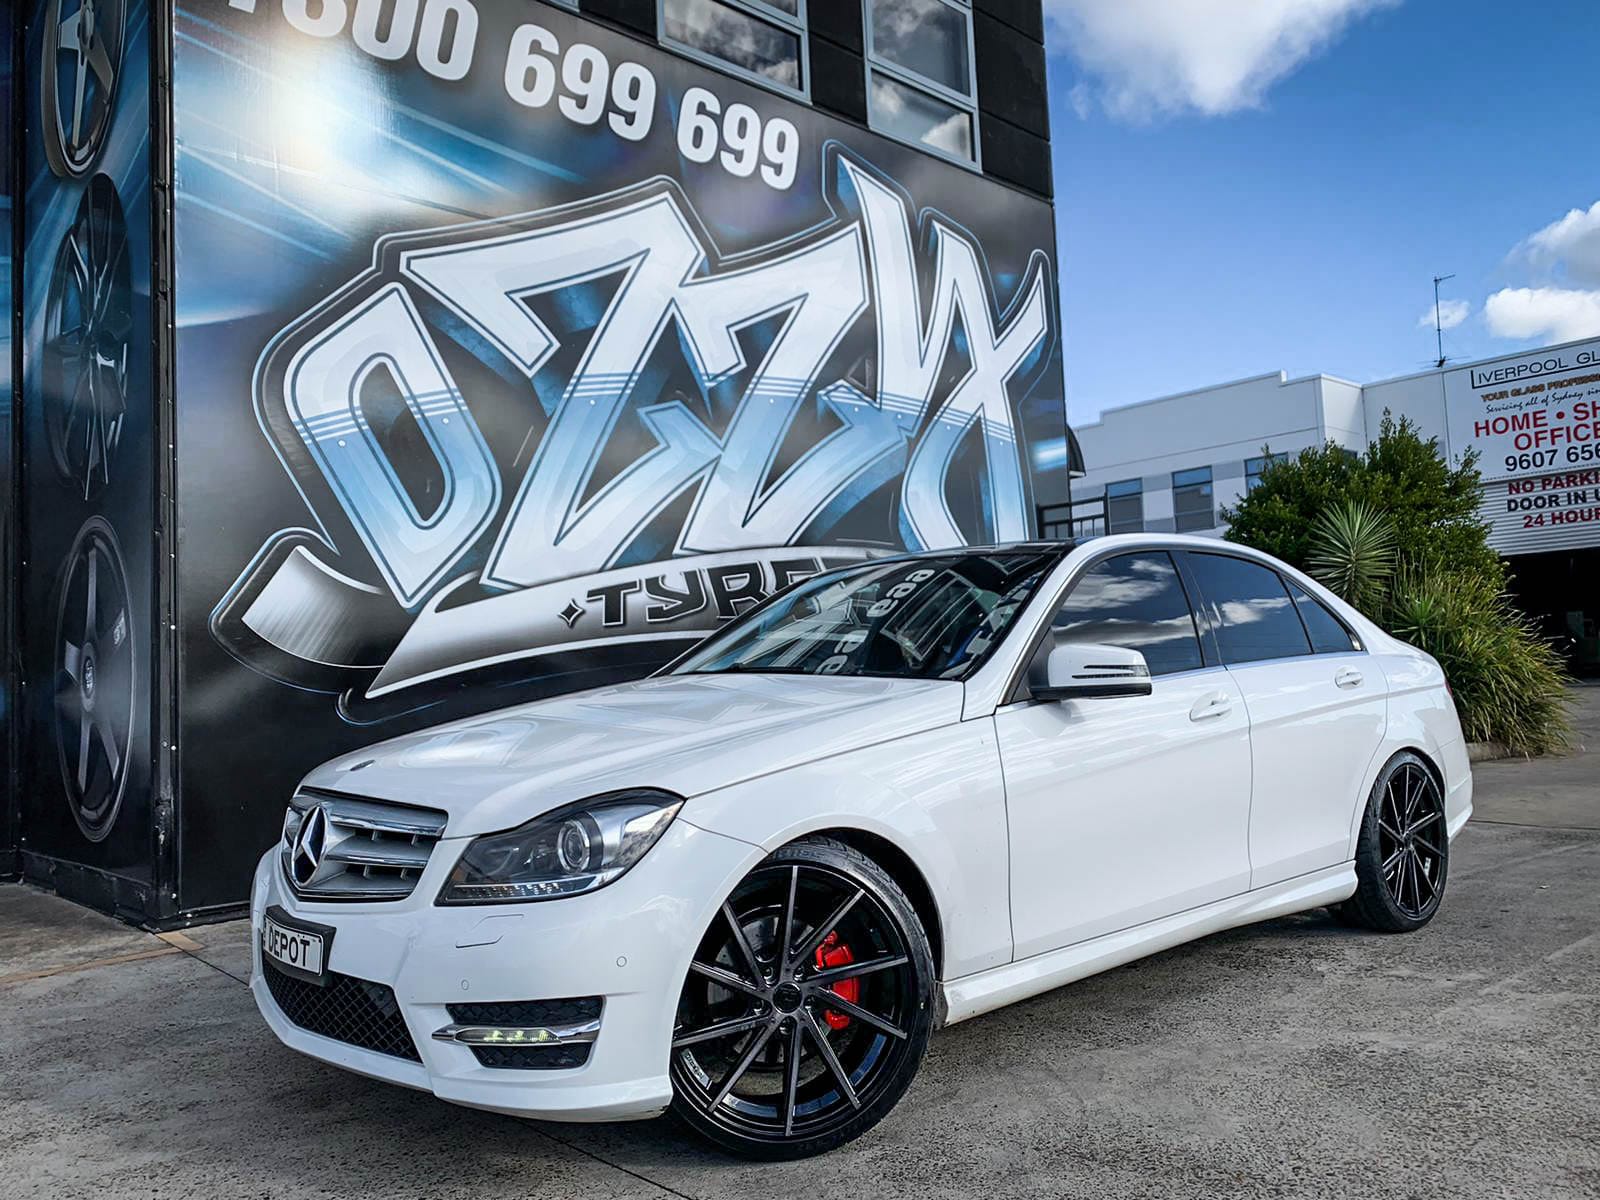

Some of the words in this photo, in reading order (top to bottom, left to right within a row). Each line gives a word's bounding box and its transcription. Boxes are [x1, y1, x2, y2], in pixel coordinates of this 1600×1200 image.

[228, 0, 479, 81] 00
[504, 23, 657, 141] 699
[676, 87, 799, 190] 699
[1471, 358, 1568, 389] LIVERPOOL
[1481, 390, 1509, 402] YOUR
[1510, 384, 1545, 397] GLASS
[1486, 402, 1523, 415] Servicing
[1525, 396, 1538, 407] all
[1541, 395, 1549, 406] of
[1552, 391, 1583, 404] Sydney
[1474, 410, 1548, 438] HOME
[1573, 401, 1600, 421] SH
[1514, 421, 1600, 451] OFFICE
[1505, 449, 1558, 471] 9607
[1507, 494, 1560, 512] DOOR
[1567, 490, 1587, 505] IN
[1508, 480, 1534, 495] NO
[1523, 514, 1546, 528] 24
[586, 556, 845, 627] TYR
[268, 925, 310, 967] DEPOT
